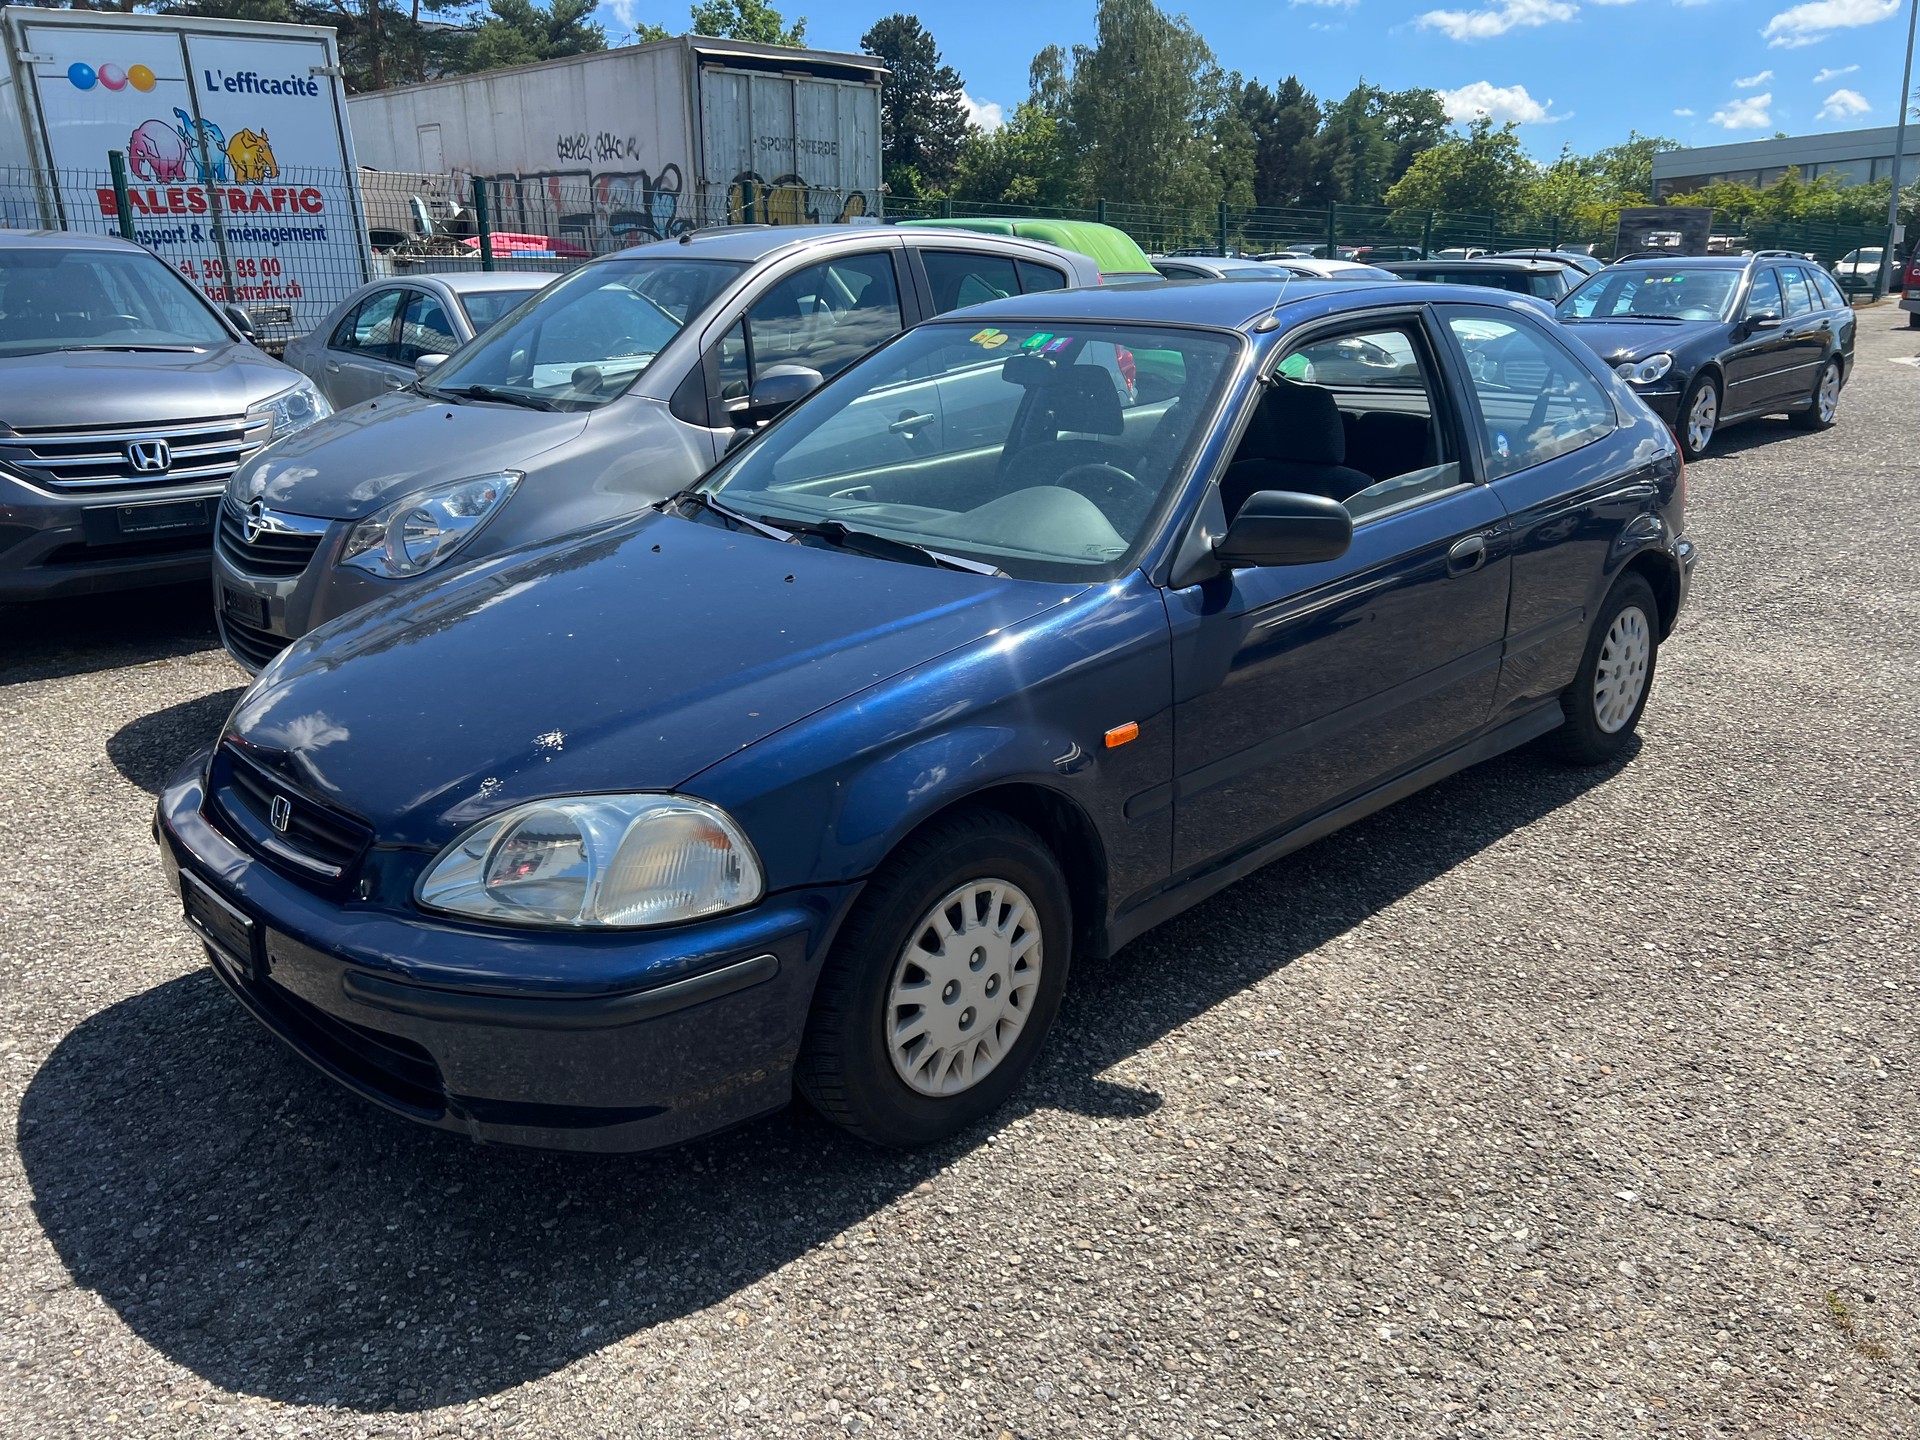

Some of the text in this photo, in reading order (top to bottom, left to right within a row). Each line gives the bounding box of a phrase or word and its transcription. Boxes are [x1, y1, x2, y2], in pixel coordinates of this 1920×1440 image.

[204, 69, 319, 97] L'efficacité
[760, 136, 795, 152] SPORT
[190, 223, 204, 244] &
[236, 258, 257, 278] 88
[261, 257, 281, 277] 00
